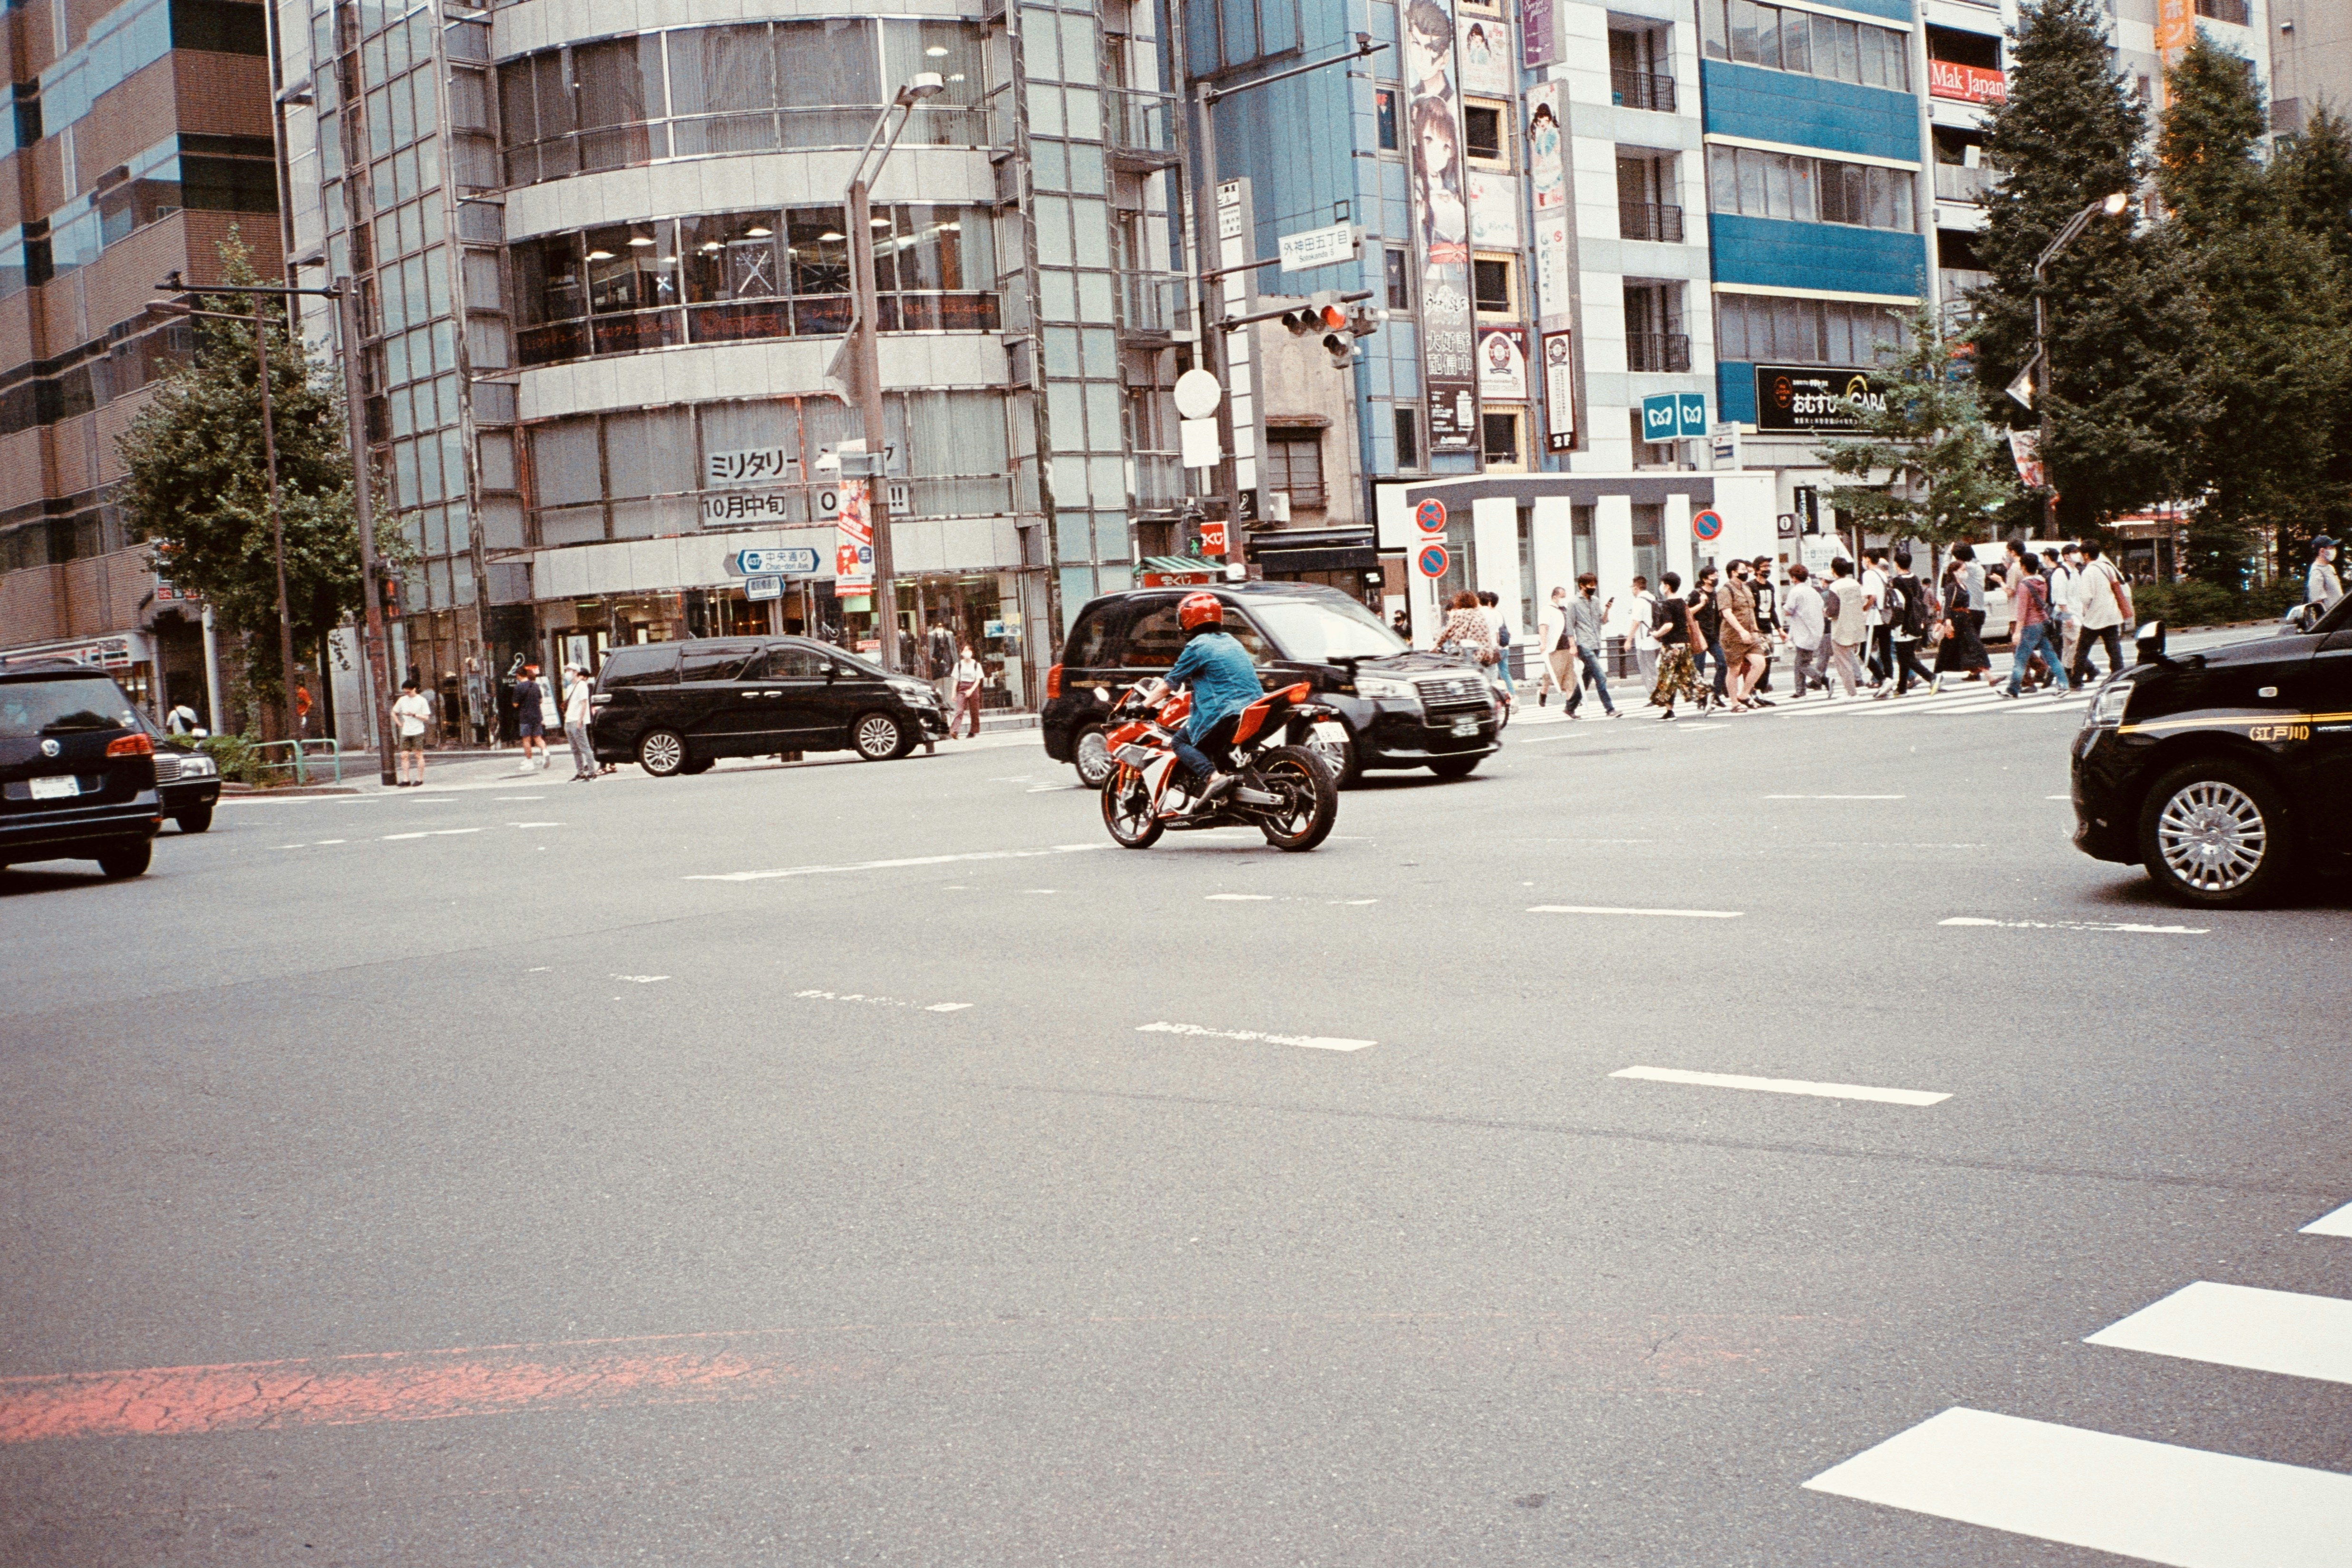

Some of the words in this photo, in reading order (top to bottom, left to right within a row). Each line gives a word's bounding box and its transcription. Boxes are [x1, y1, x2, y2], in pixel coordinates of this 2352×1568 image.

[1931, 63, 1964, 89] Mak
[1964, 69, 2004, 100] Japan
[1284, 230, 1347, 255] 外神田五丁目
[1299, 251, 1328, 263] Sotokanda
[1426, 331, 1471, 352] 大好評
[1427, 354, 1472, 376] 配信中
[1793, 393, 1838, 414] おむすび
[1553, 434, 1570, 448] 2F
[712, 449, 798, 479] ミリタリー
[703, 494, 785, 519] 10月中旬
[748, 557, 761, 566] 437
[766, 551, 808, 563] 中央通り
[1160, 575, 1192, 586] 宝くじ
[2250, 725, 2310, 741] (江戸川)
